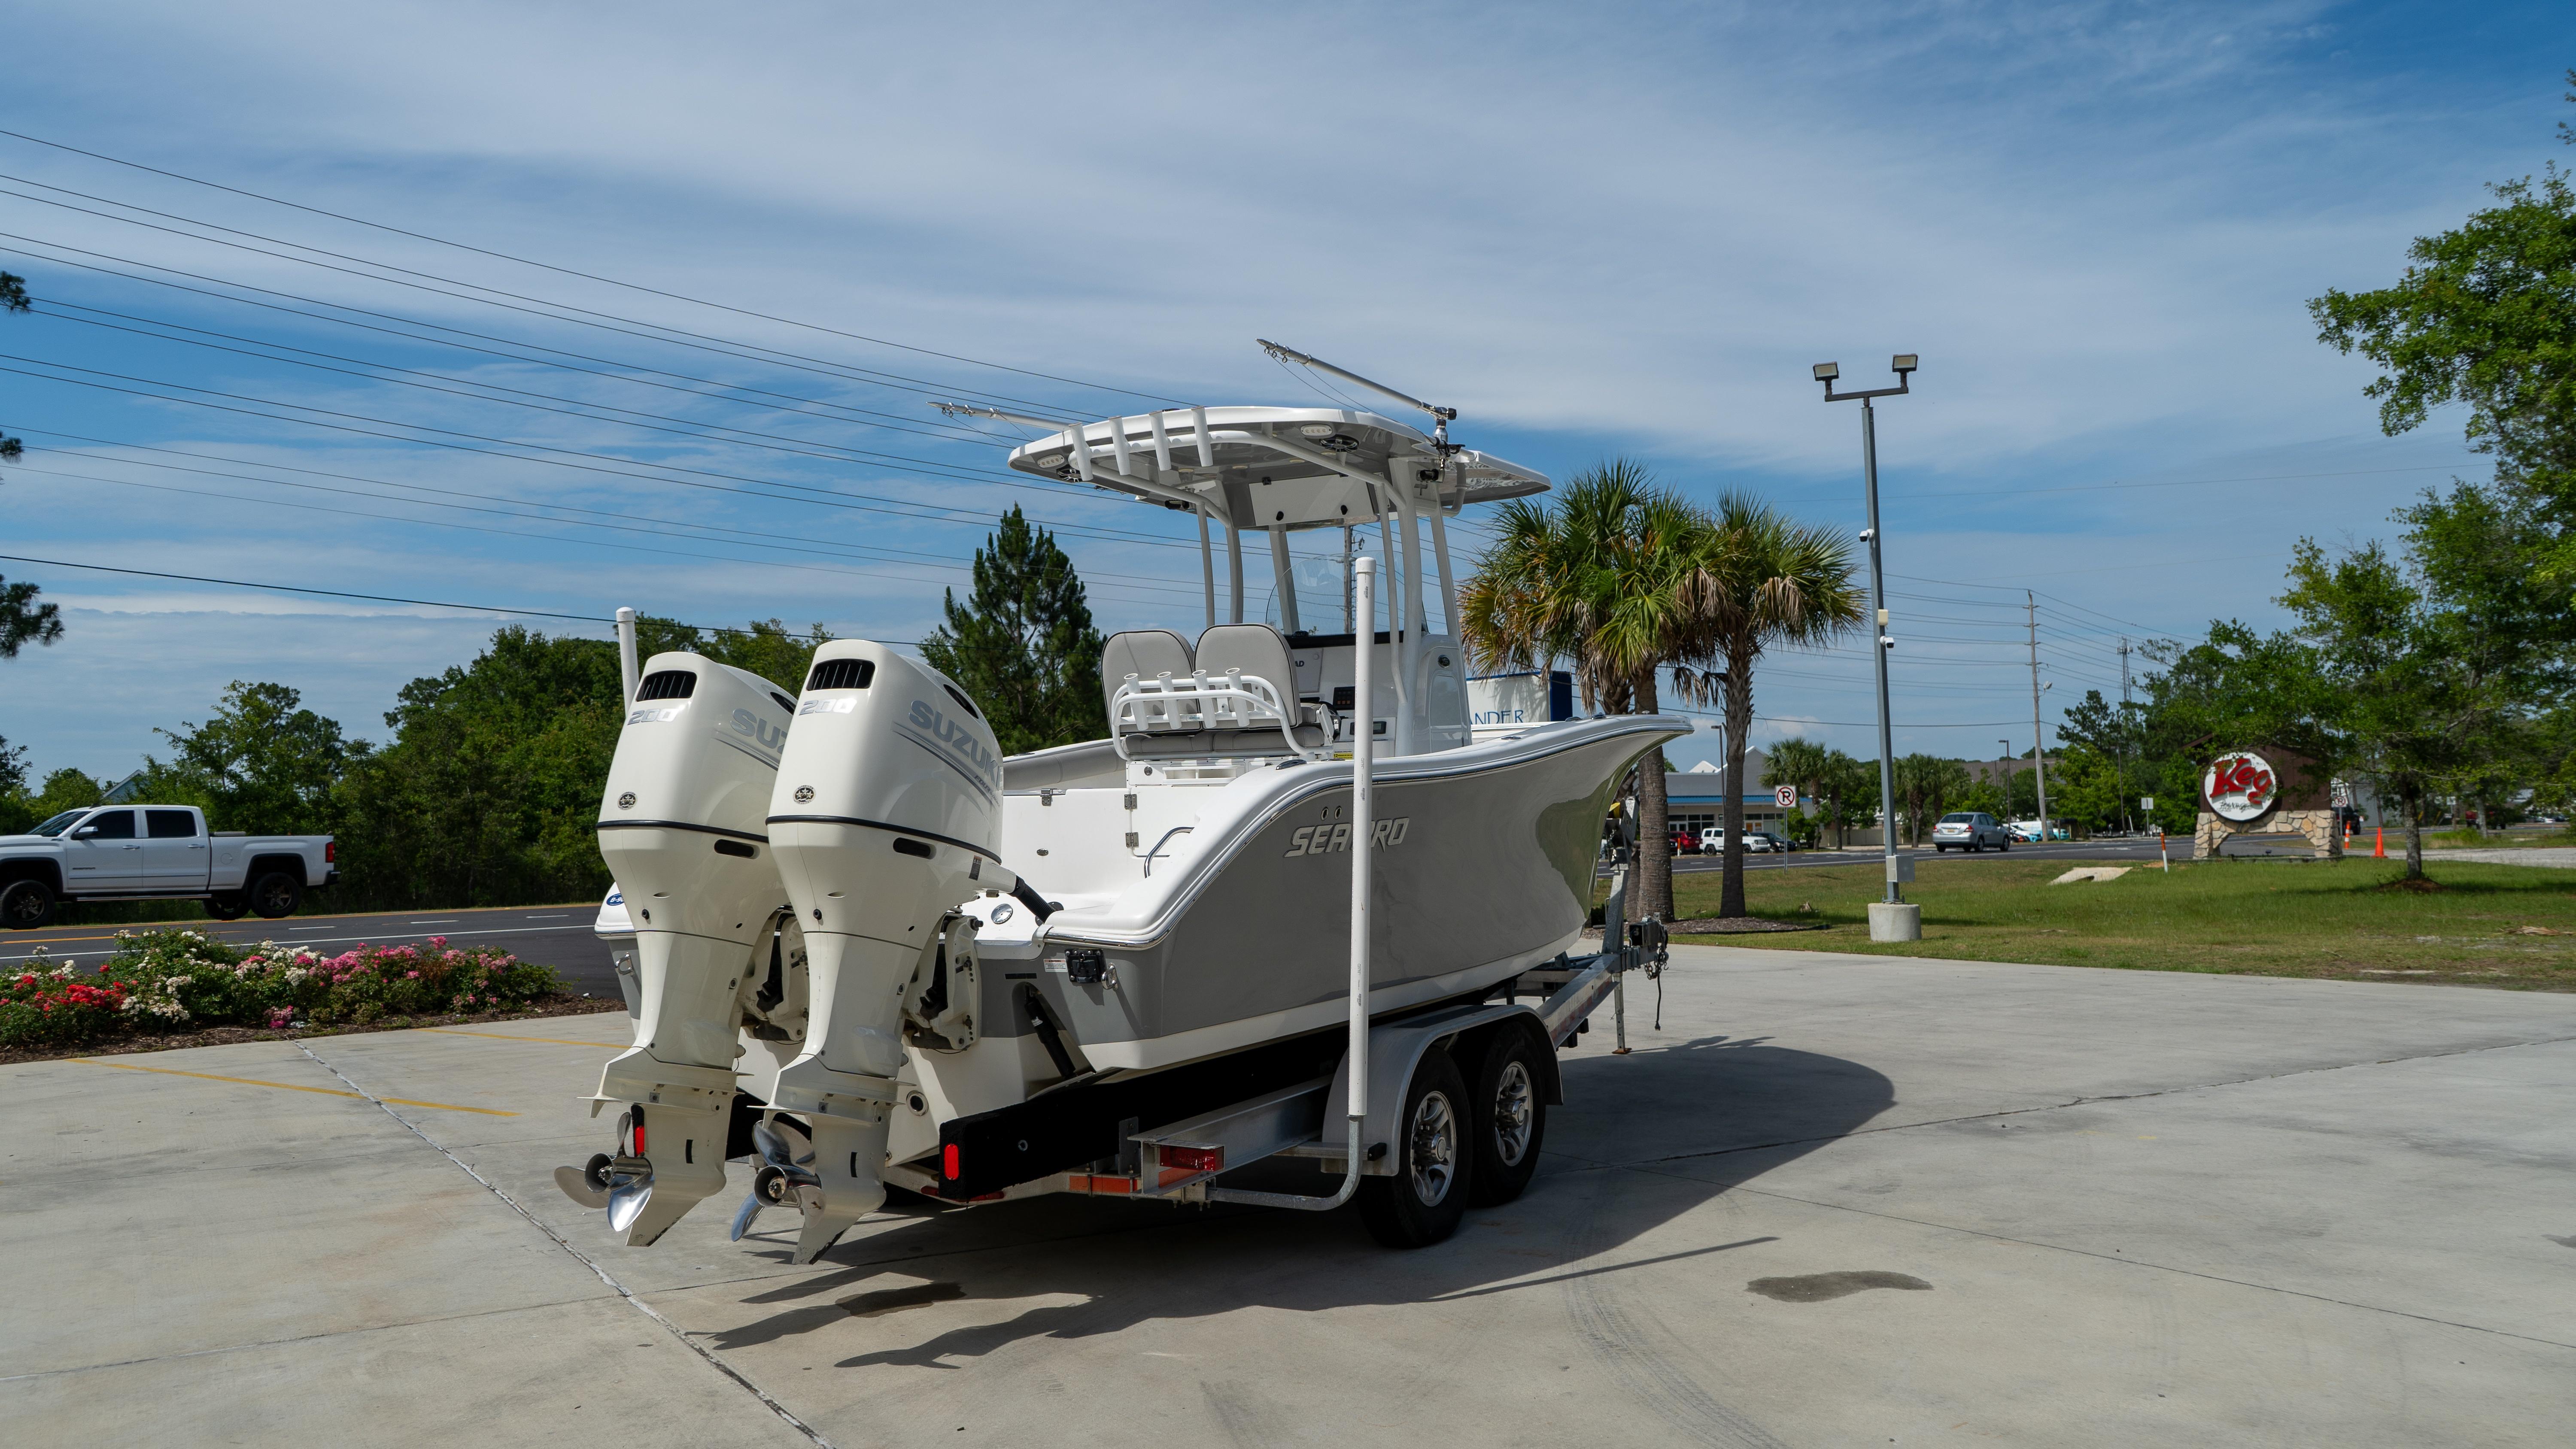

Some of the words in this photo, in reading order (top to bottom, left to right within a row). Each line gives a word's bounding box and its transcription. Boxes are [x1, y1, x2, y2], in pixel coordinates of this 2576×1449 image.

[627, 708, 679, 725] 200
[799, 698, 857, 716] 200
[1470, 709, 1523, 725] NDER
[908, 700, 1003, 791] SUZUKI
[2209, 758, 2272, 804] Keg
[1283, 823, 1352, 857] SEA
[1350, 817, 1410, 852] RO
